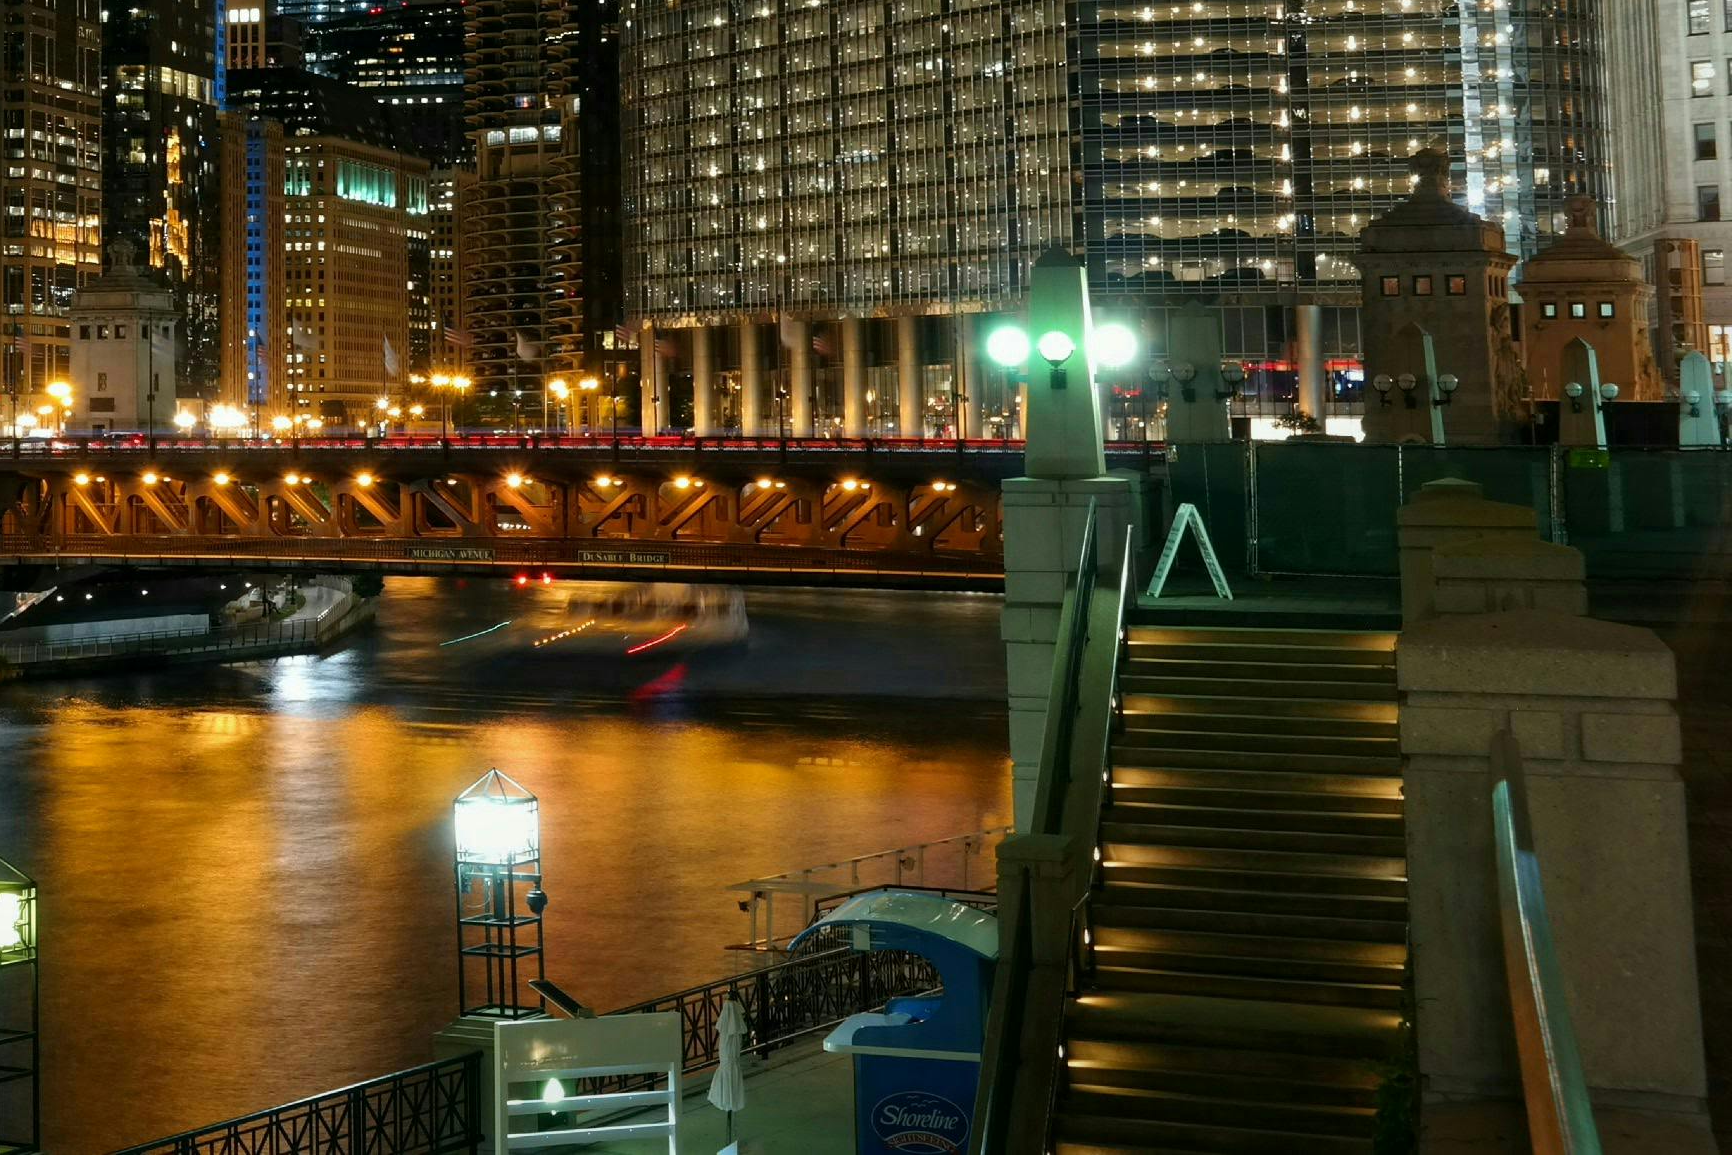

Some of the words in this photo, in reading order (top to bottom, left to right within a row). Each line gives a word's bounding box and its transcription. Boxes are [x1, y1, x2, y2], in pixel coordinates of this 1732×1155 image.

[412, 549, 456, 558] MICHIGAN
[459, 550, 491, 559] AVENUE
[880, 1104, 959, 1130] Shoreline
